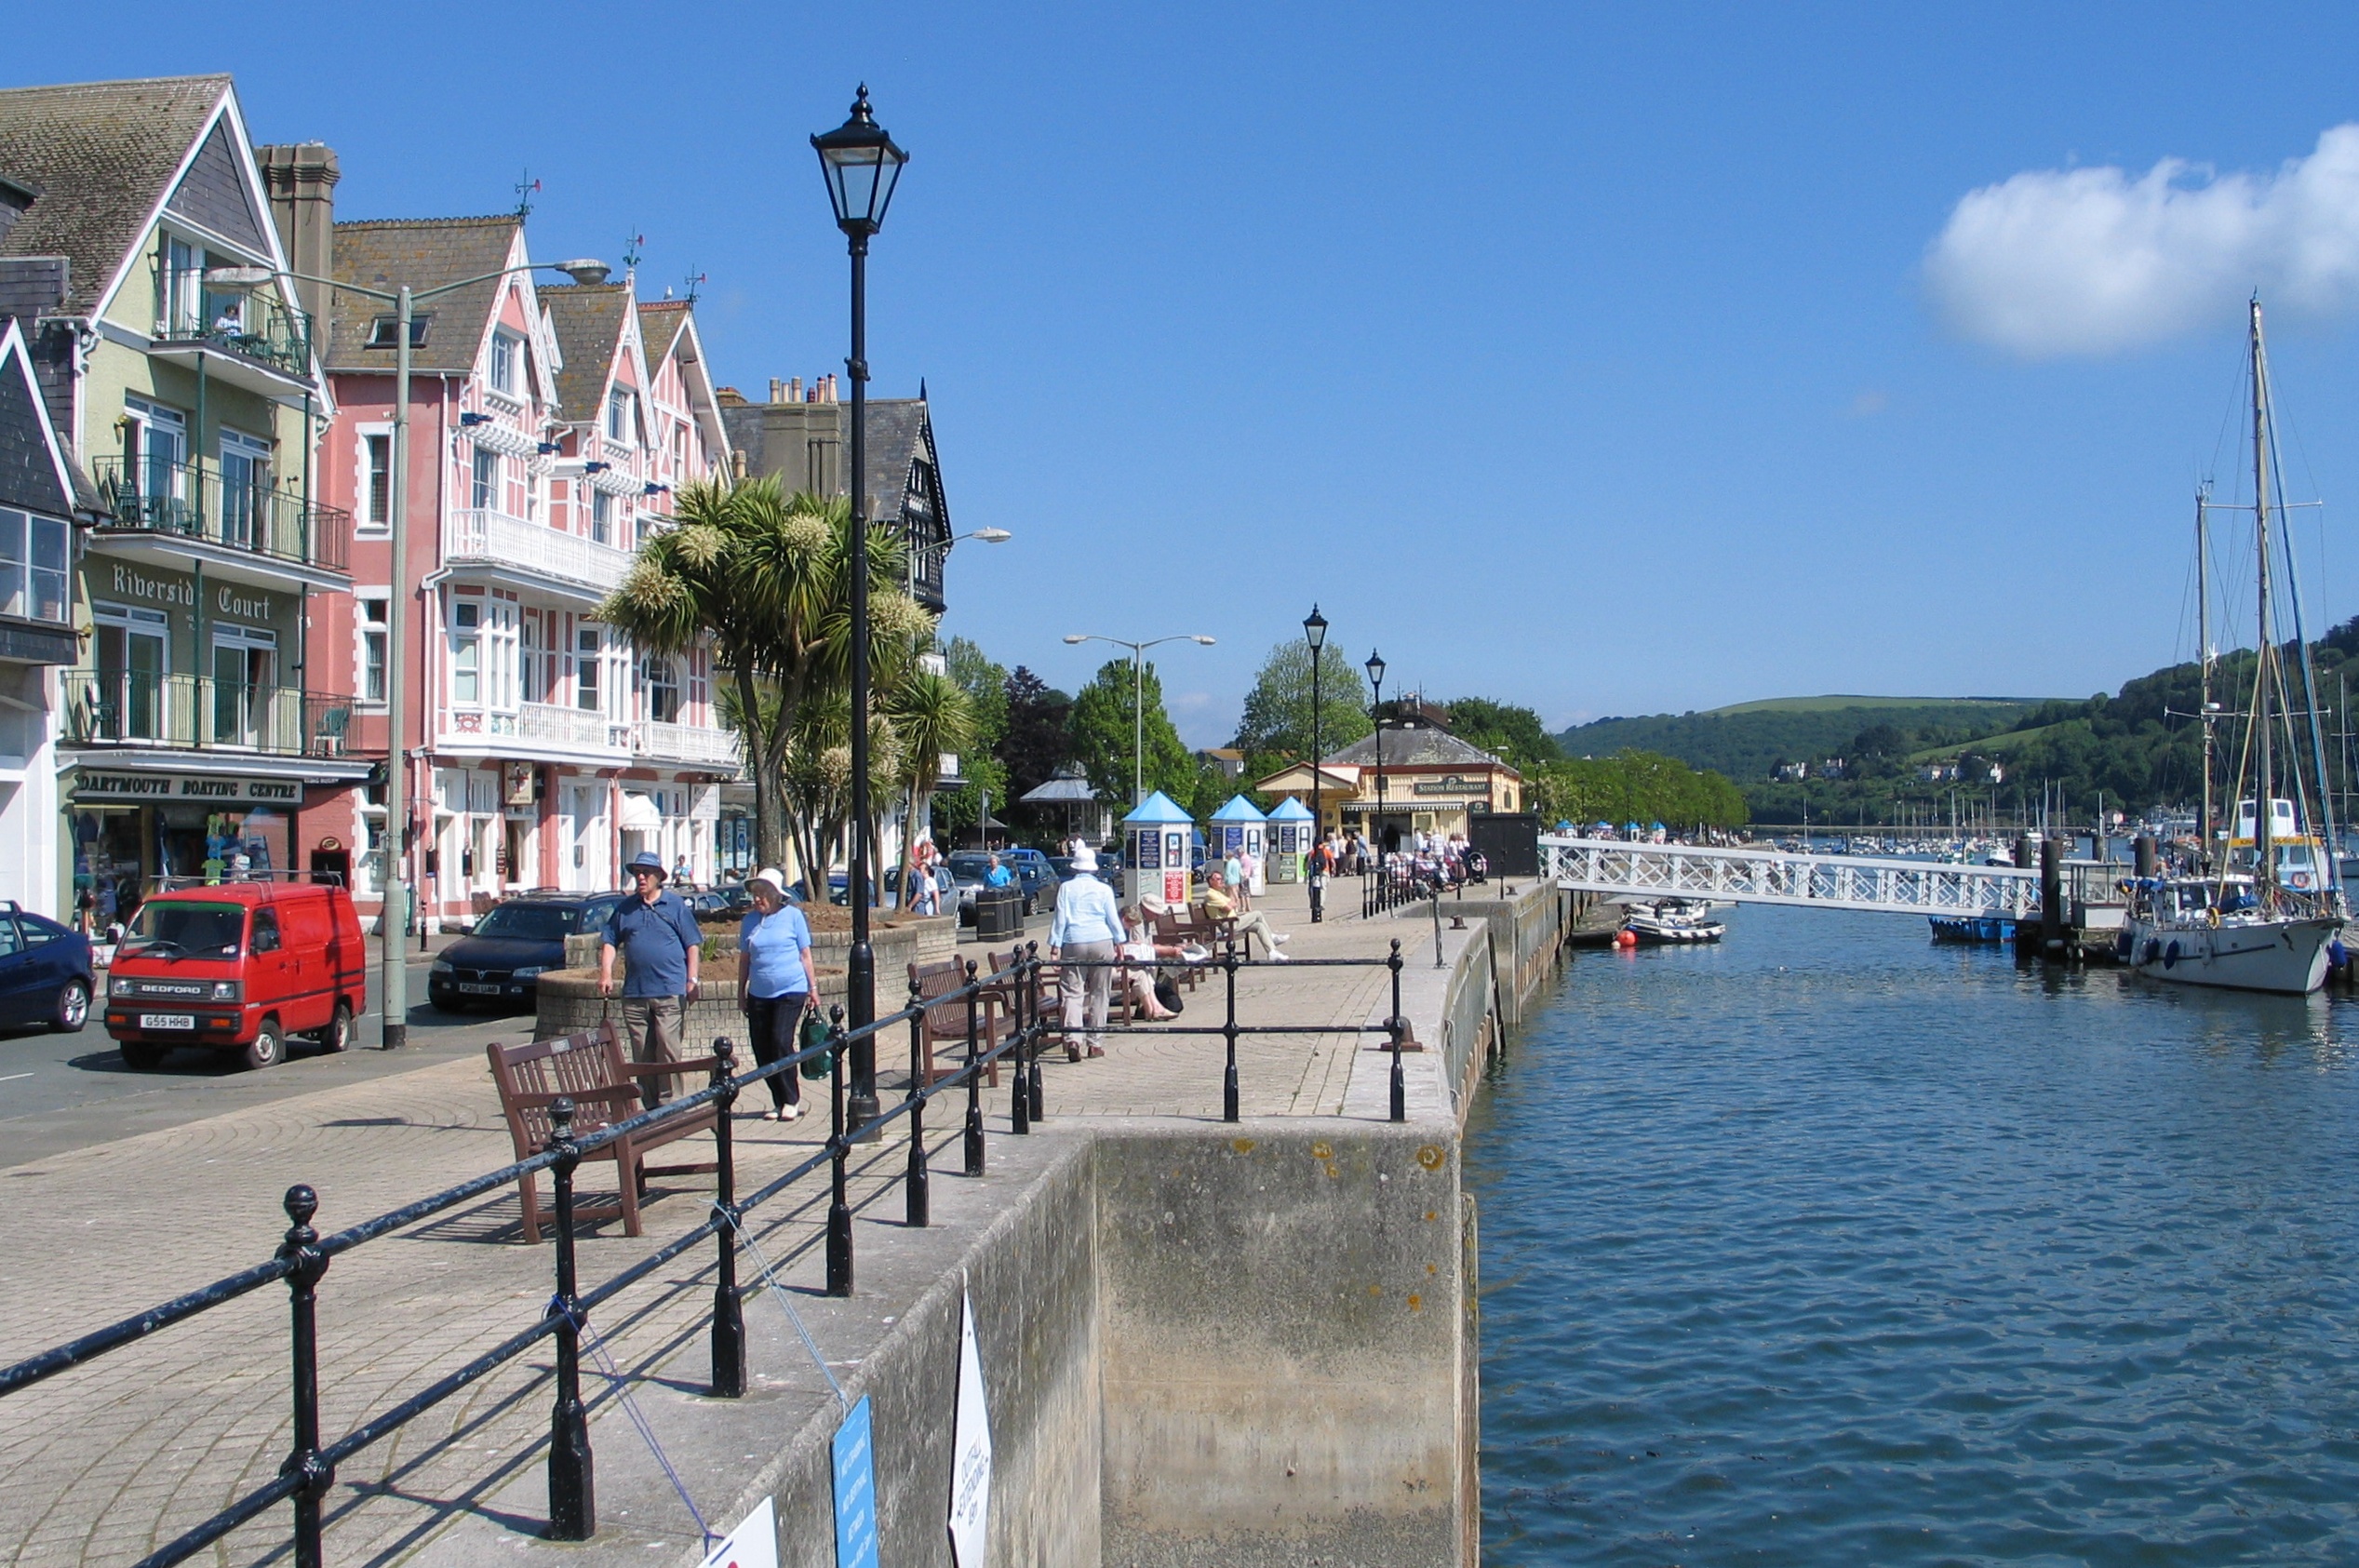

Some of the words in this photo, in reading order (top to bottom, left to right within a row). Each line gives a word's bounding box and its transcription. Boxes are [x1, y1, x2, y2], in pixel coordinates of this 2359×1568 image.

[113, 563, 194, 606] Riversid
[218, 585, 270, 621] Court
[78, 774, 171, 795] DARTMOUTH
[181, 780, 238, 797] BOATING
[249, 783, 296, 798] CENTRE
[141, 985, 201, 994] BEDFORD
